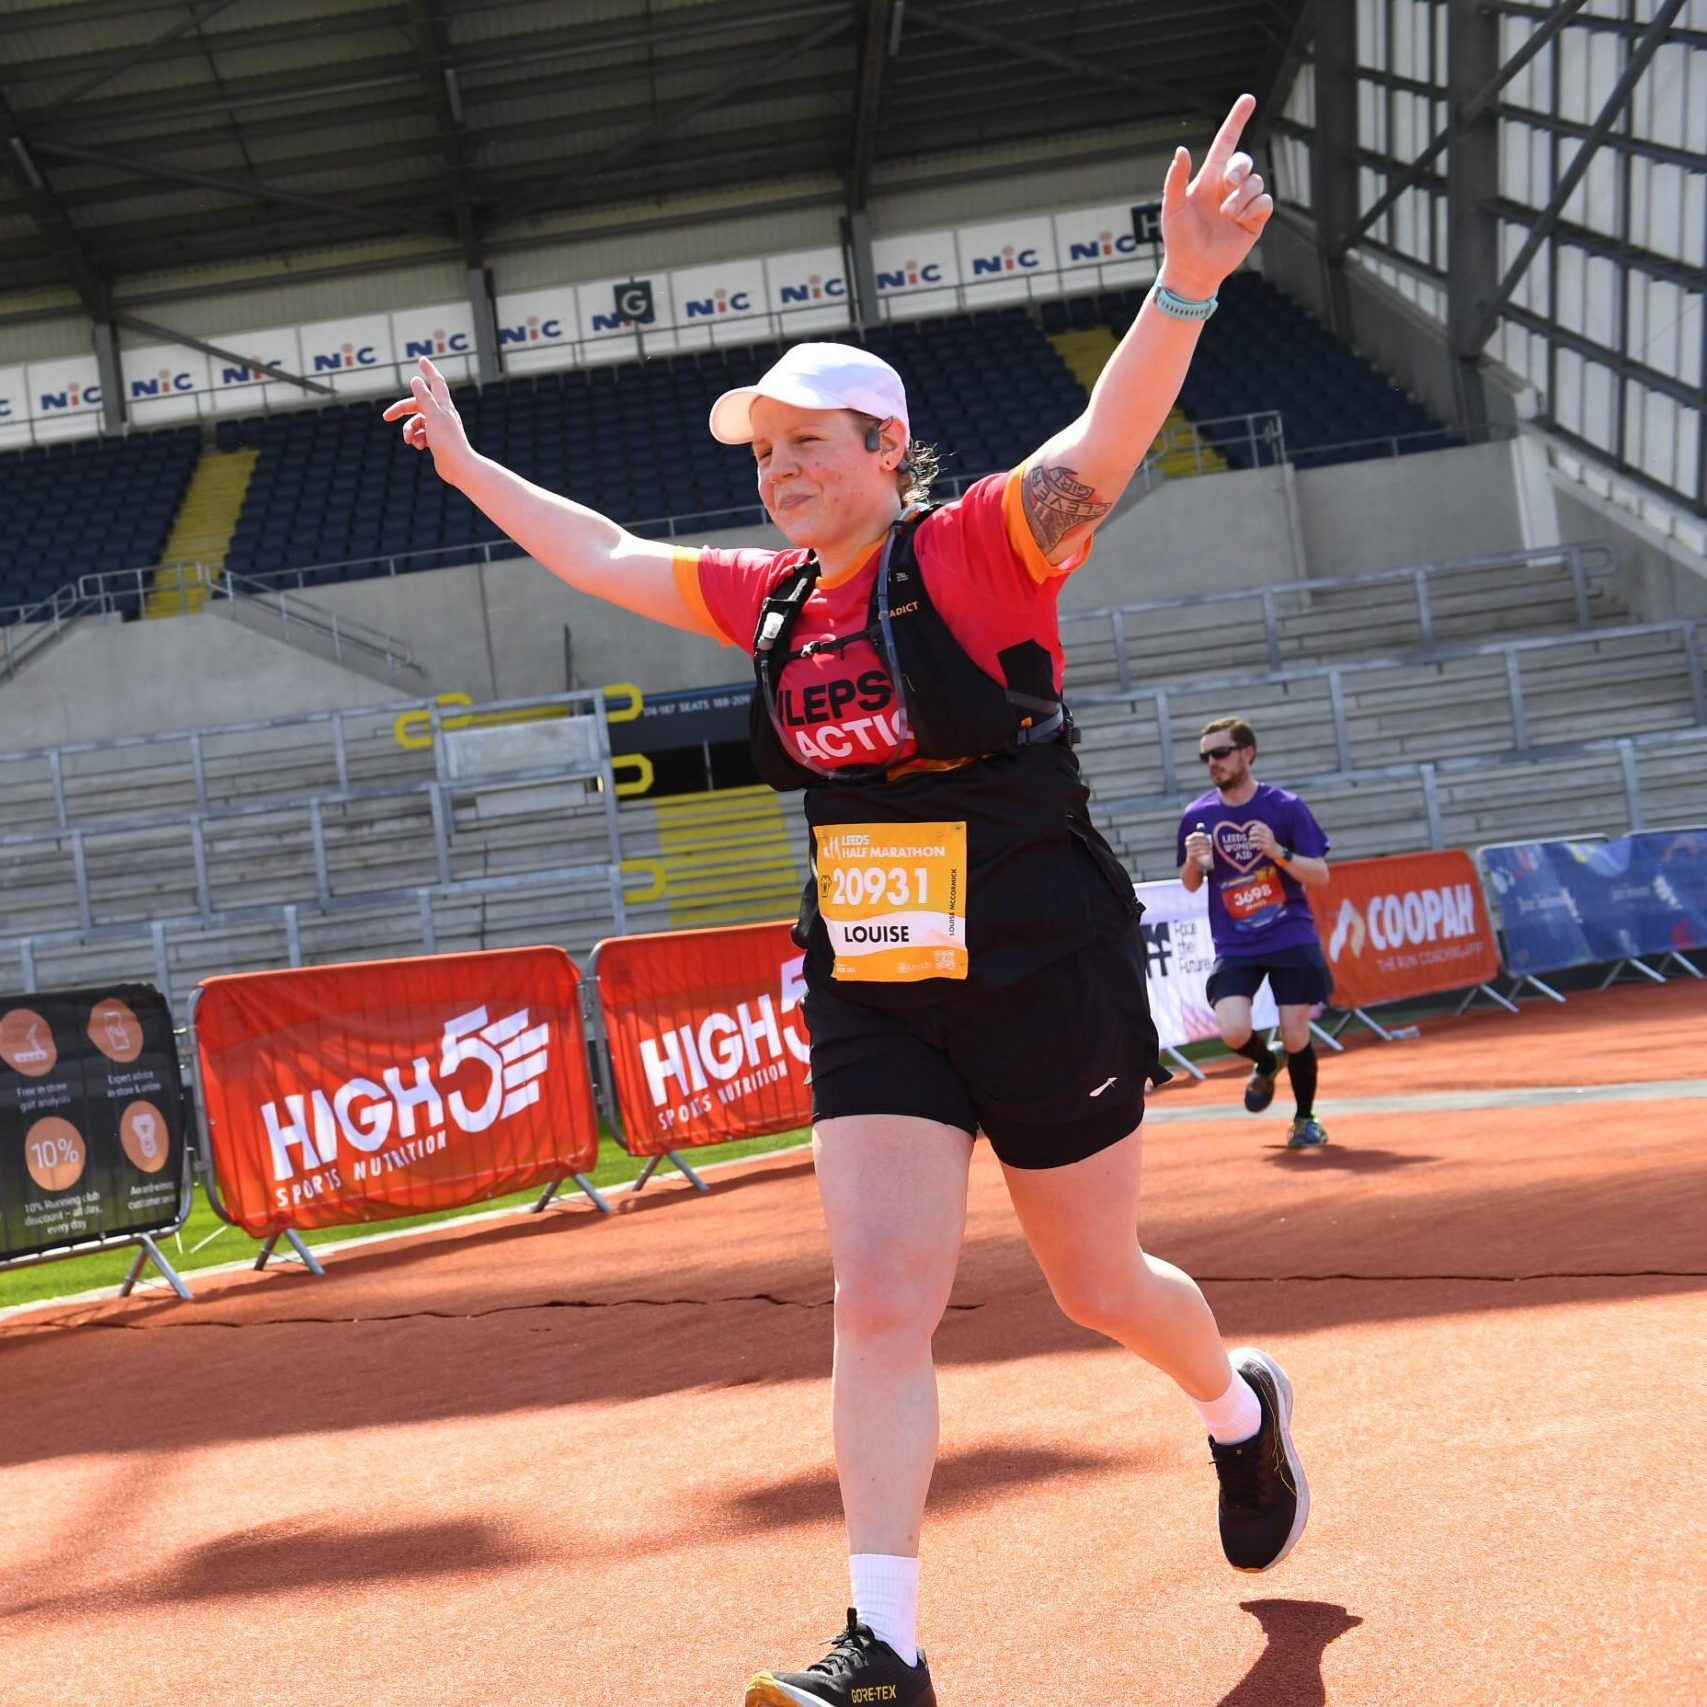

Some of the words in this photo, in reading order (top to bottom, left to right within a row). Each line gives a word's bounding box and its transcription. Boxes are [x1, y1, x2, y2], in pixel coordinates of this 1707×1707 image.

[621, 289, 647, 316] G
[841, 834, 869, 845] LEEDS
[1222, 833, 1248, 843] LEEDS
[842, 847, 868, 858] HALF
[870, 846, 945, 858] MARATHON
[1235, 851, 1253, 861] AID
[832, 867, 928, 905] 20931
[949, 868, 957, 910] MCCORMICK
[1234, 884, 1273, 906] 3698
[1368, 883, 1475, 951] COOPAH
[844, 926, 910, 943] LOUISE
[260, 1004, 504, 1182] HIGH5
[658, 1093, 713, 1131] SPORTS
[717, 1059, 788, 1106] NUTRITION
[31, 1137, 80, 1169] 10%
[275, 1167, 343, 1208] SPORTS
[353, 1130, 447, 1181] NUTRITION
[44, 1196, 82, 1210] Running
[25, 1211, 64, 1226] discount
[851, 1684, 897, 1704] GORE-TEX
